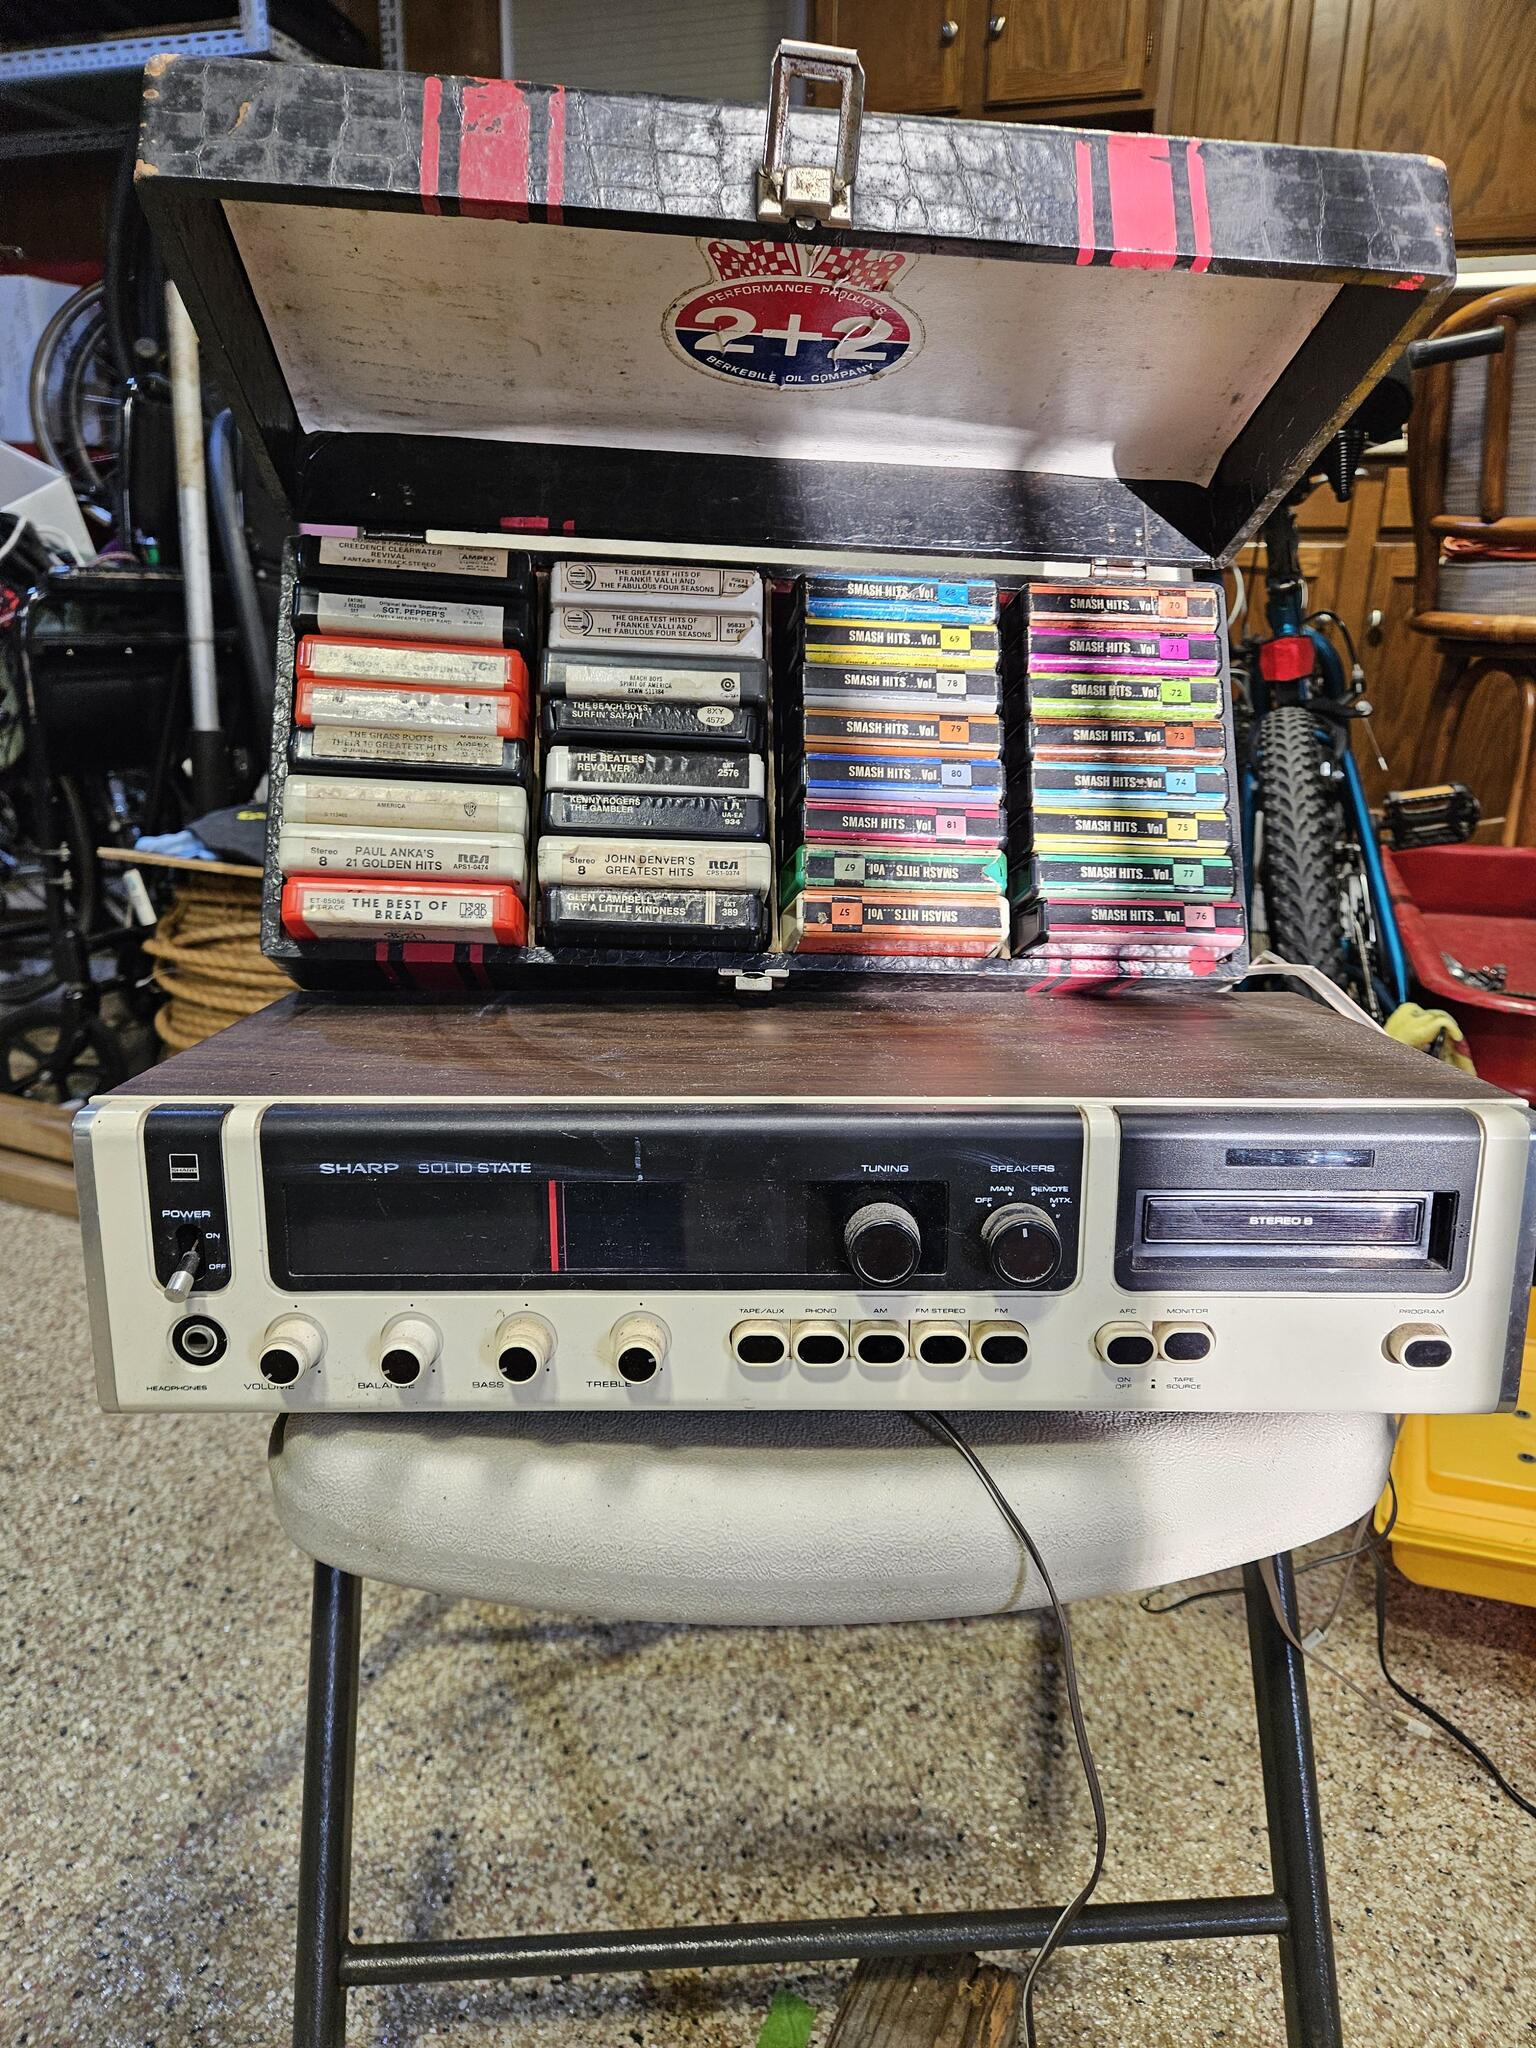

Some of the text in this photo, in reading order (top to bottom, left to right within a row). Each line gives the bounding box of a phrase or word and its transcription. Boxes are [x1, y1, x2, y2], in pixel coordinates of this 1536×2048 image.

[707, 284, 887, 315] PERFORMANCE PRODUCTS
[694, 306, 895, 362] 2+2
[705, 355, 875, 383] BERKEBILE OIL COMPANY
[338, 542, 443, 556] CREEDENCE CLEARWATER
[370, 551, 406, 560] REVIVAL
[461, 554, 496, 562] AMPEX
[1070, 598, 1104, 610] SMASH
[382, 606, 446, 618] SGT. PEPPER'S
[628, 615, 667, 623] GREATEST
[616, 621, 650, 629] FRANKIE
[652, 622, 675, 630] VALLI
[614, 628, 654, 636] FABULOUS
[655, 629, 676, 637] FOUR
[678, 630, 712, 638] SEASONS
[849, 630, 884, 644] SMASH
[1069, 641, 1104, 653] SMASH
[844, 674, 880, 687] SMASH
[1071, 684, 1106, 696] SMASH
[592, 703, 622, 711] BEACH
[624, 704, 648, 712] BOYS
[571, 710, 643, 720] SURFIN' SAFARI
[706, 716, 726, 724] 4572
[846, 721, 882, 734] SMASH
[951, 725, 962, 733] 79
[349, 730, 433, 742] THE GRASS ROOTS
[1073, 730, 1109, 742] SMASH
[578, 753, 645, 763] THE BEATLES
[577, 763, 630, 772] REVOLVER
[718, 769, 739, 777] 2576
[849, 766, 884, 779] SMASH
[1074, 775, 1110, 787] SMASH
[1175, 778, 1186, 786] 74
[569, 795, 641, 806] KENNY ROGERS
[569, 804, 633, 813] THE GAMBLER
[842, 815, 878, 829] SMASH
[947, 821, 957, 829] 81
[1075, 820, 1111, 832] SMASH
[310, 846, 338, 855] Stereo
[355, 846, 434, 859] PAUL ANKA'S
[318, 856, 328, 867] 8
[457, 853, 489, 864] RCA
[605, 854, 695, 865] JOHN DENVER'S
[346, 858, 442, 871] 21 GOLDEN HITS
[453, 863, 489, 871] APS1-0474
[708, 860, 738, 870] RCA
[844, 864, 856, 872] 67
[578, 866, 586, 875] 8
[605, 866, 694, 877] GREATEST HITS
[923, 864, 959, 878] SMASH
[1080, 866, 1116, 879] SMASH
[567, 893, 653, 904] GLEN CAMPBELL
[352, 898, 379, 908] THE
[386, 899, 420, 910] BEST
[428, 901, 449, 911] OF
[566, 903, 587, 911] TRY
[599, 904, 633, 914] LITTLE
[635, 905, 686, 916] KINDNESS
[375, 910, 423, 921] BREAD
[722, 908, 738, 917] 389
[839, 908, 850, 916] 57
[922, 909, 958, 923] SMASH
[1091, 909, 1127, 921] SMASH
[1196, 912, 1207, 920] 76
[319, 1163, 532, 1175] SHARP SOLID STATE
[861, 1164, 909, 1173] TUNING
[990, 1164, 1055, 1173] SPEAKERS
[162, 1210, 211, 1218] POWER
[1249, 1216, 1313, 1225] STEREO 8
[243, 1383, 296, 1391] VOLUME
[472, 1381, 504, 1389] BASS
[585, 1380, 633, 1389] TREBLE
